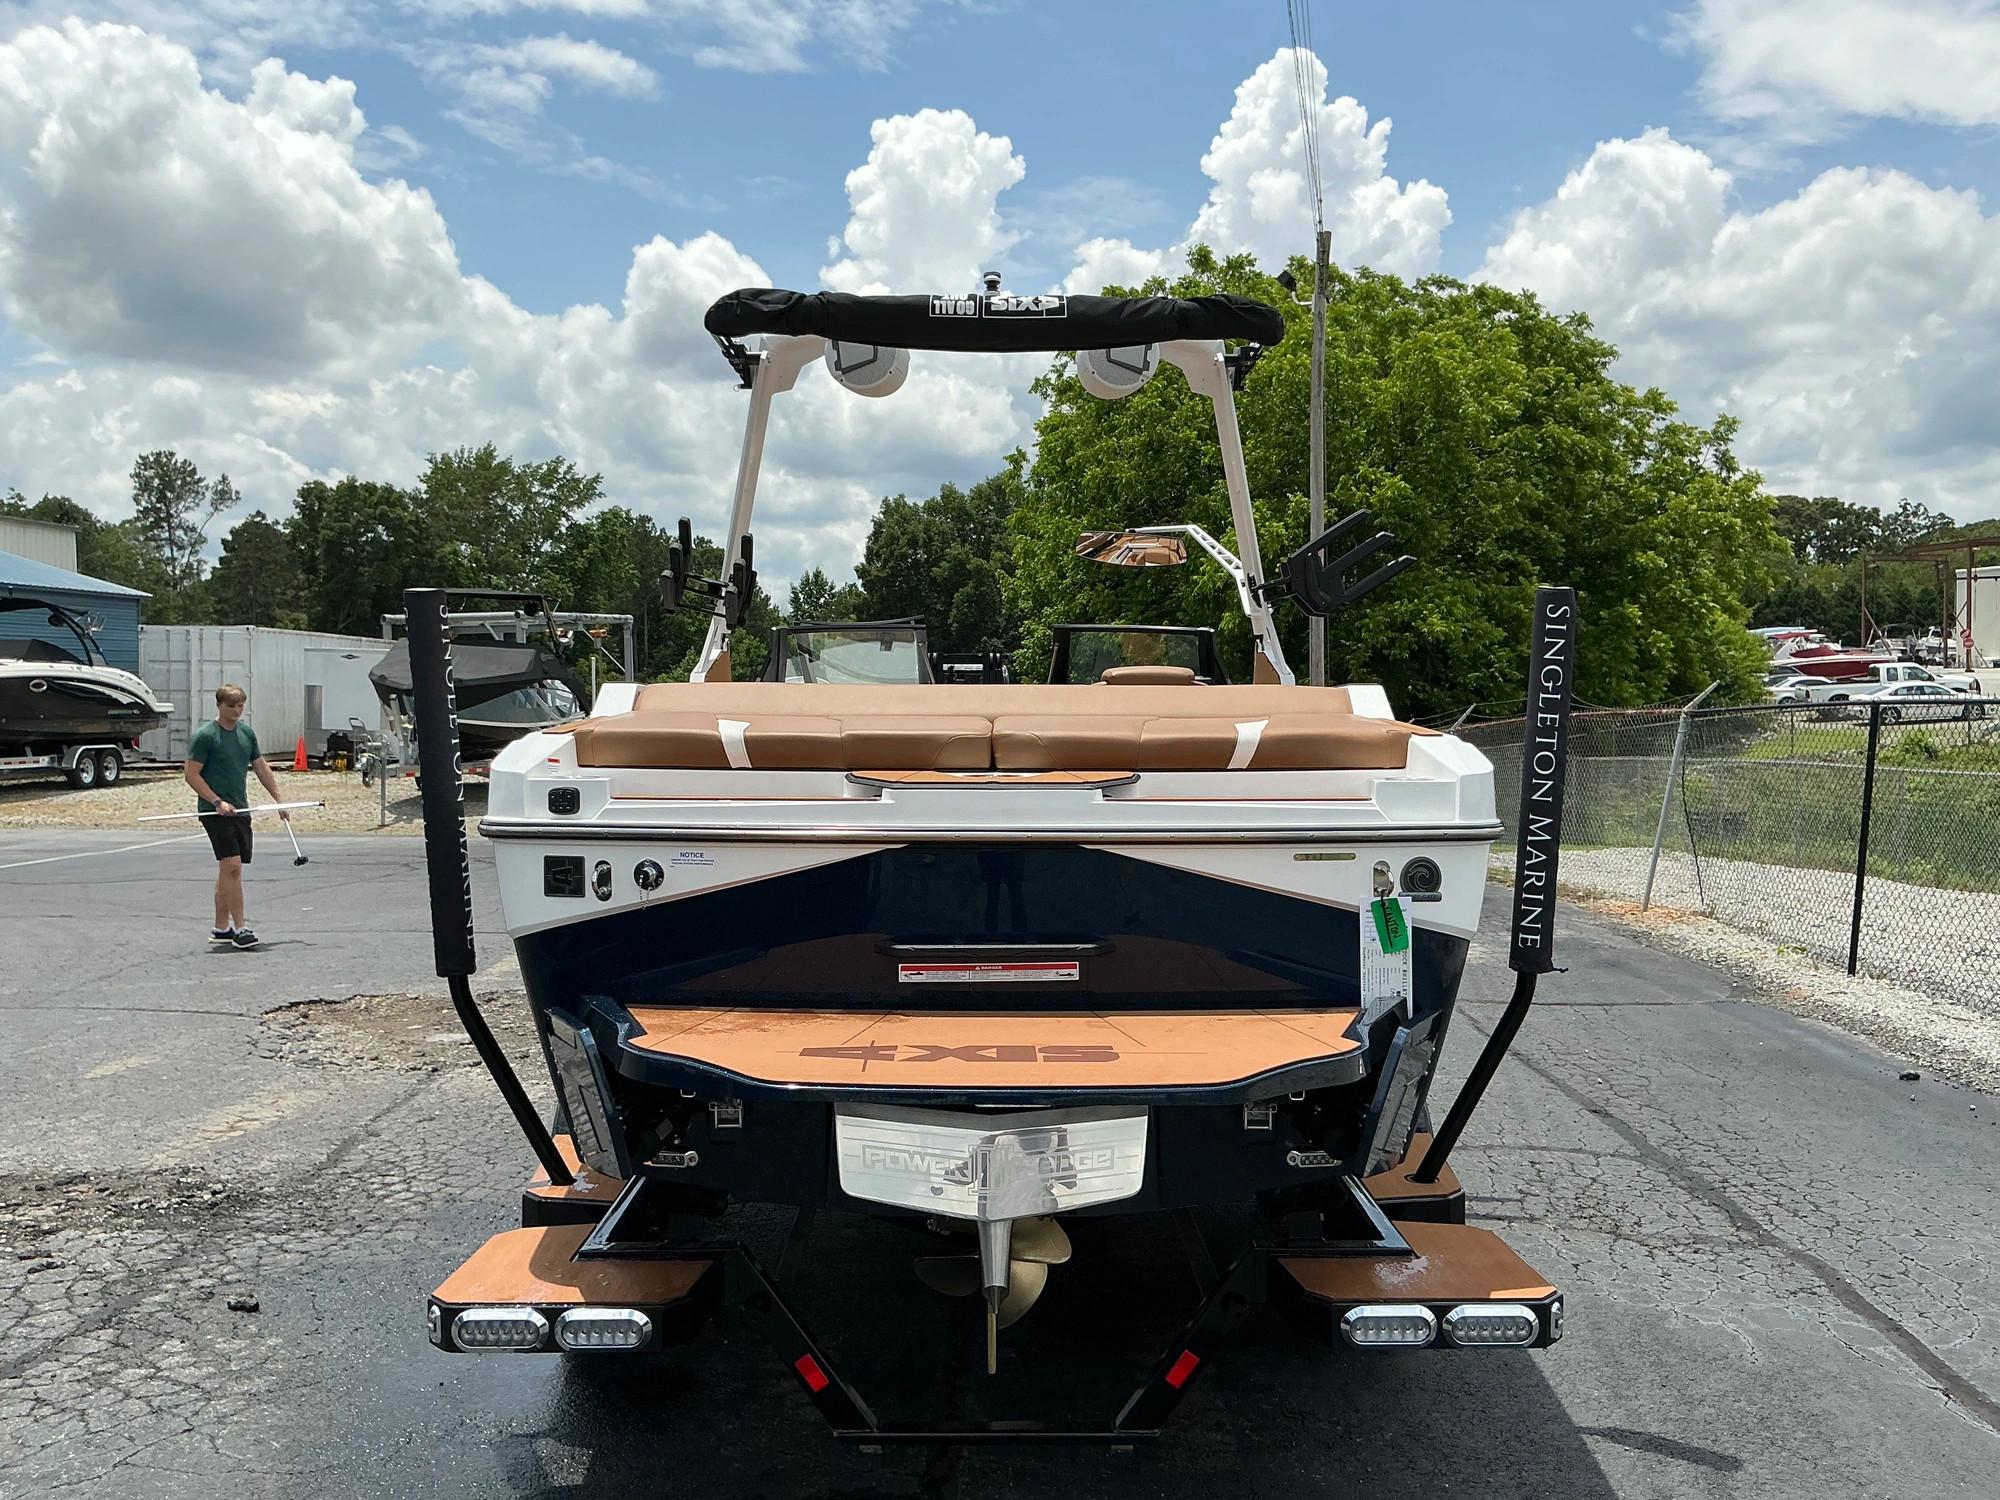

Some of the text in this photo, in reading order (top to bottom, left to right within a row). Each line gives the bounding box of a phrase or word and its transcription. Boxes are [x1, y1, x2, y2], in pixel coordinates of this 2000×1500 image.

[1518, 603, 1571, 950] SINGLETON MARINE
[799, 1040, 1120, 1073] AXIS
